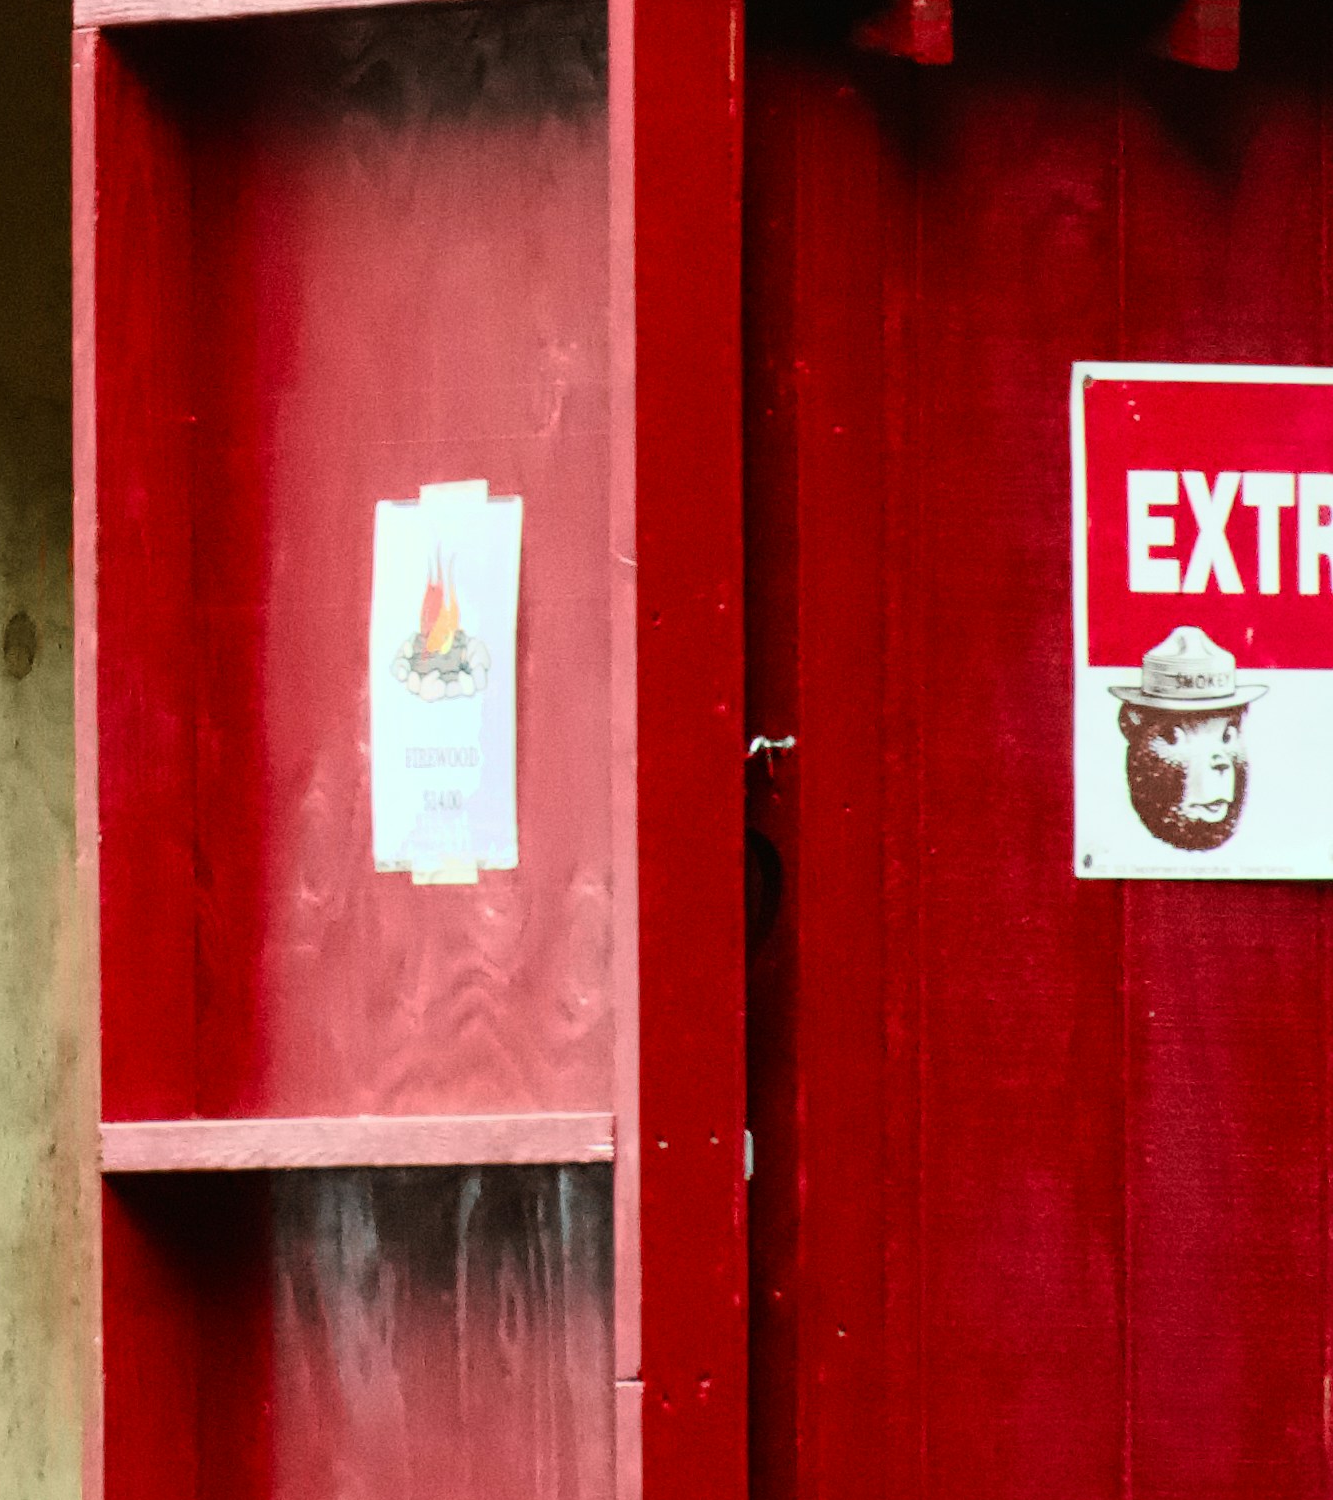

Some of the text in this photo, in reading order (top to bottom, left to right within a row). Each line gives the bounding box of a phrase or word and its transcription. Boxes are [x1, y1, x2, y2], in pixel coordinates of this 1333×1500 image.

[1126, 469, 1333, 596] EXTR
[1174, 672, 1232, 690] SMOKEY
[406, 747, 479, 768] FIREWOOD
